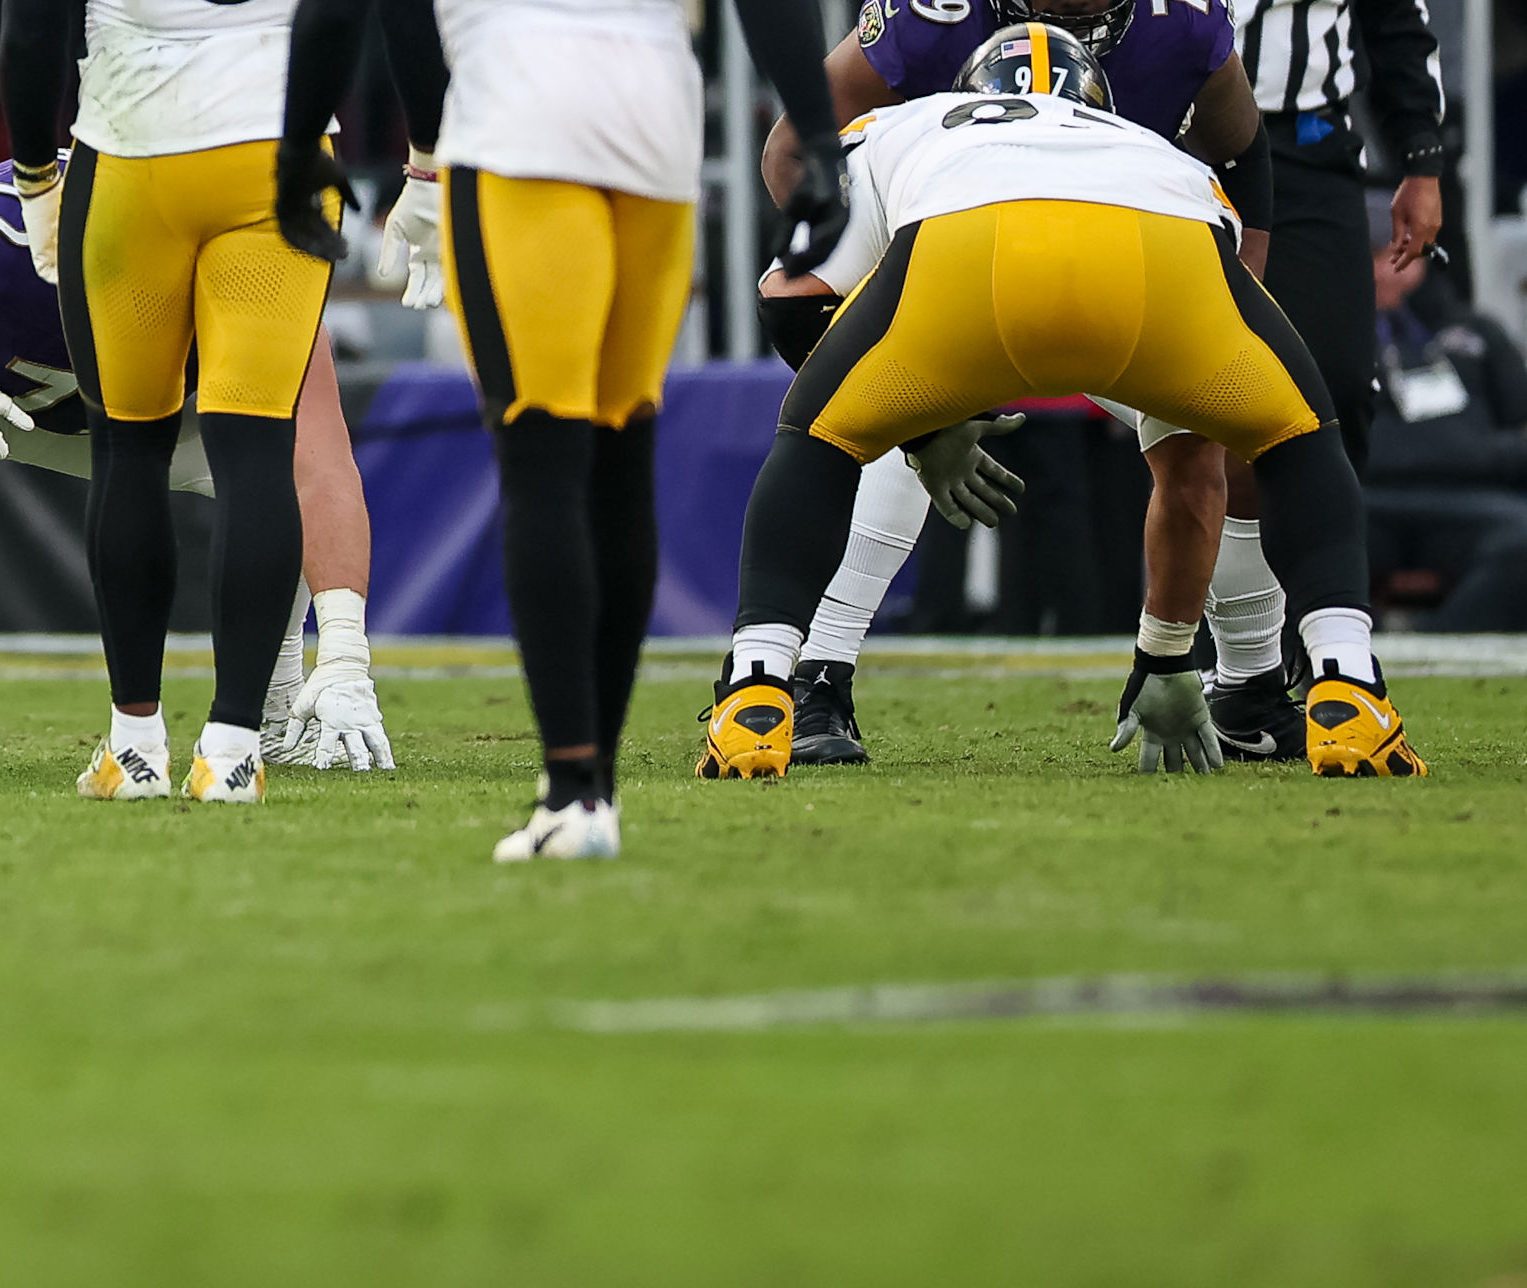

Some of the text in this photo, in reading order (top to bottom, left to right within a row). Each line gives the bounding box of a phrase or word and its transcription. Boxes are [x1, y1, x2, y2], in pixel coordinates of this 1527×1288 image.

[1014, 66, 1069, 96] 97
[116, 747, 160, 784] NIKE
[225, 753, 256, 792] NIKE
